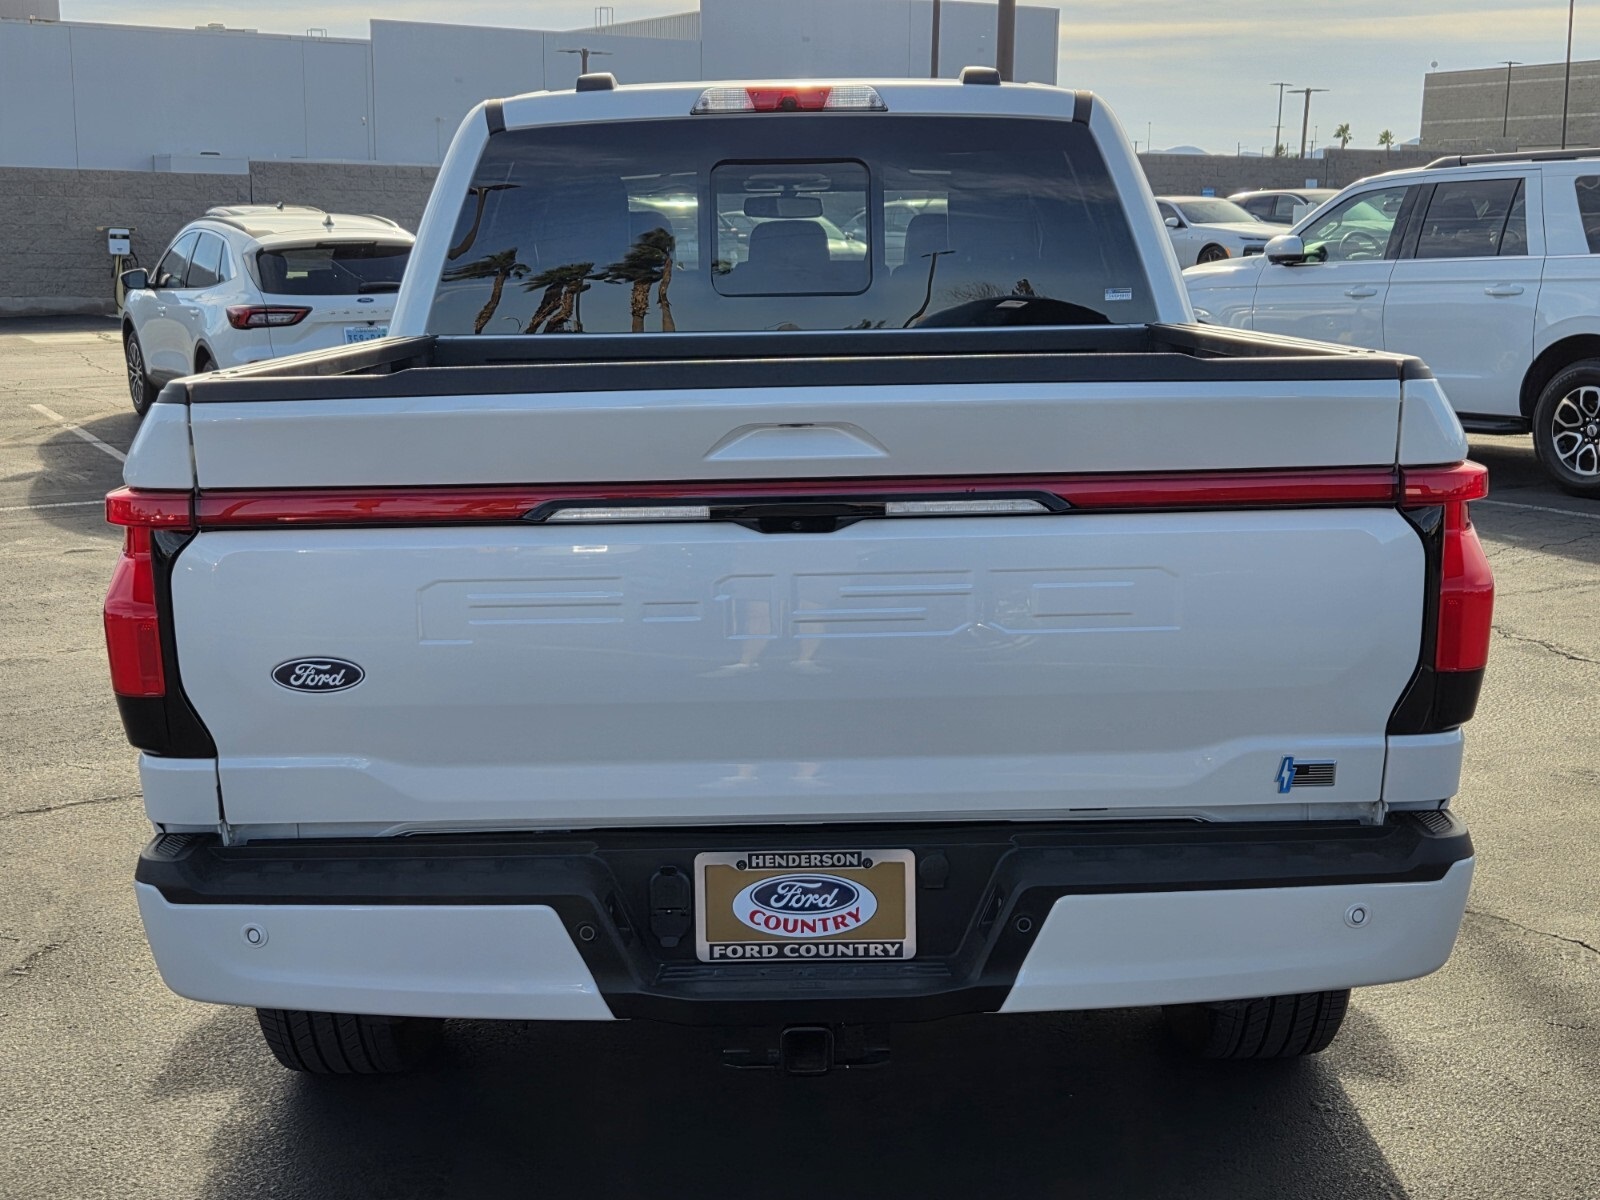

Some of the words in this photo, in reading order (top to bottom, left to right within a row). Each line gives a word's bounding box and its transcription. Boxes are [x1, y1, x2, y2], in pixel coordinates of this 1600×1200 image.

[416, 565, 1181, 646] F-150
[290, 663, 346, 686] Ford
[751, 853, 859, 868] HENDERSON
[770, 881, 838, 909] Ford
[749, 907, 862, 934] COUNTRY
[713, 945, 779, 959] FORD
[783, 943, 900, 958] COUNTRY
